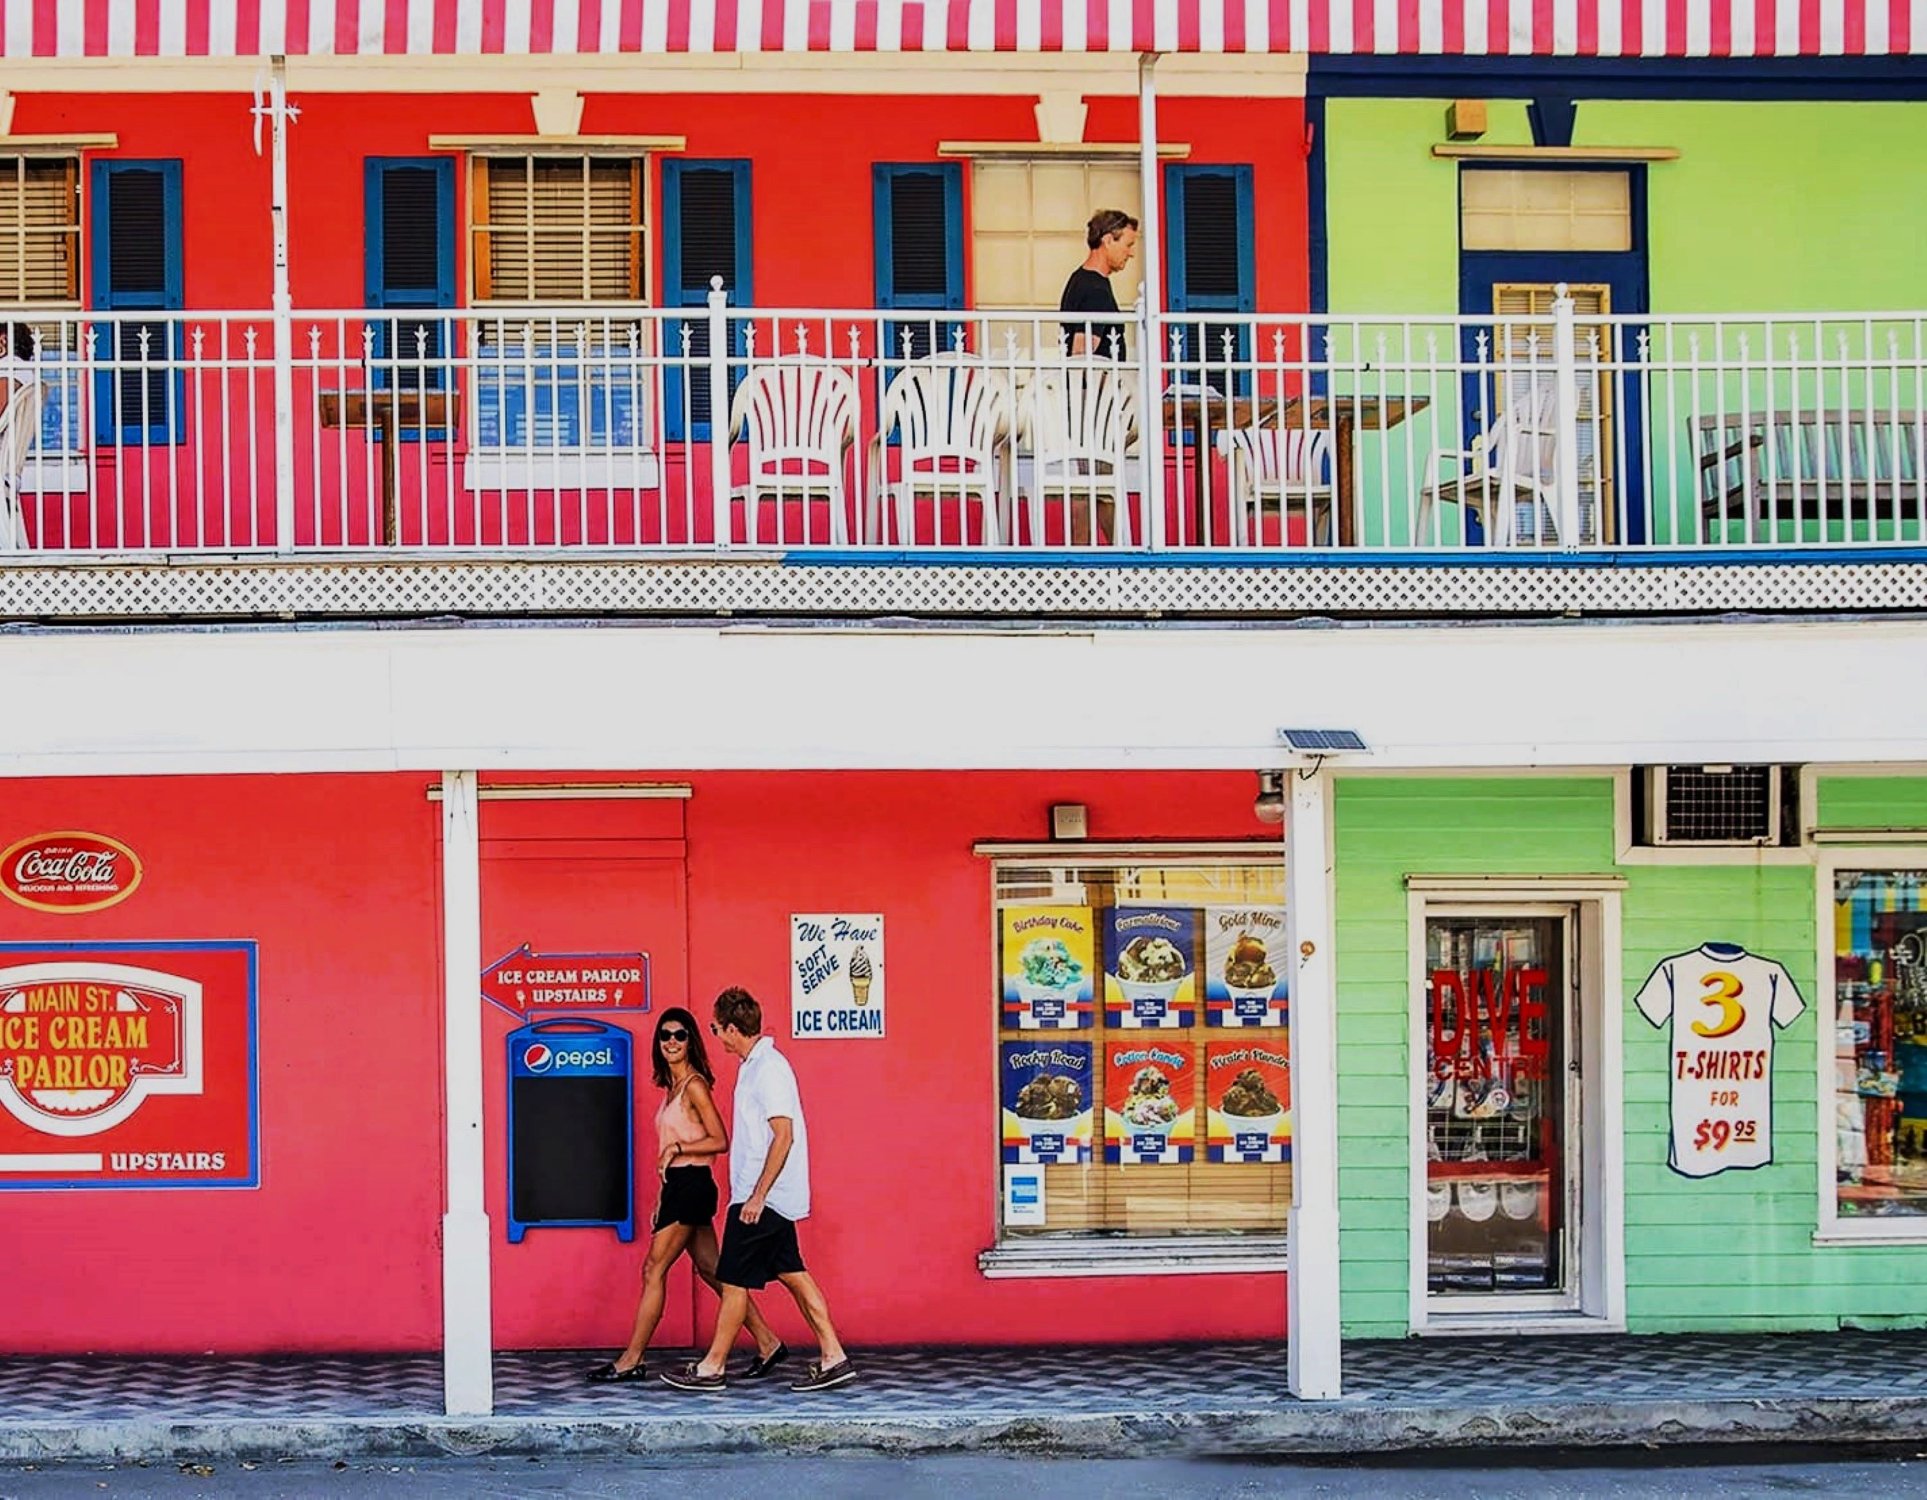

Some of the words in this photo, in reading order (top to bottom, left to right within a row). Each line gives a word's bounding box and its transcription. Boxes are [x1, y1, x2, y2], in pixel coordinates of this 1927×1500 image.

[798, 922, 826, 941] We
[830, 920, 877, 941] Have
[1013, 915, 1058, 933] Birthday
[1218, 913, 1246, 932] Gold
[1250, 911, 1282, 930] Mine
[798, 944, 827, 979] SOFT
[498, 970, 523, 985] ICE
[526, 969, 578, 985] CREAM
[581, 968, 641, 983] PARLOR
[802, 954, 840, 995] SERVE
[28, 984, 79, 1012] MAIN
[85, 986, 114, 1012] ST.
[532, 988, 607, 1003] UPSTAIRS
[1690, 971, 1746, 1039] 3
[796, 1010, 823, 1032] ICE
[827, 1009, 881, 1031] CREAM
[1432, 968, 1549, 1057] DIVE
[50, 1016, 149, 1050] CREAM
[555, 1048, 612, 1069] pepsi
[1434, 1056, 1550, 1081] CENTRE
[1676, 1050, 1766, 1080] T-SHIRTS
[16, 1055, 127, 1088] PARLOR
[1710, 1091, 1740, 1107] FOR
[110, 1152, 226, 1172] UPSTAIRS
